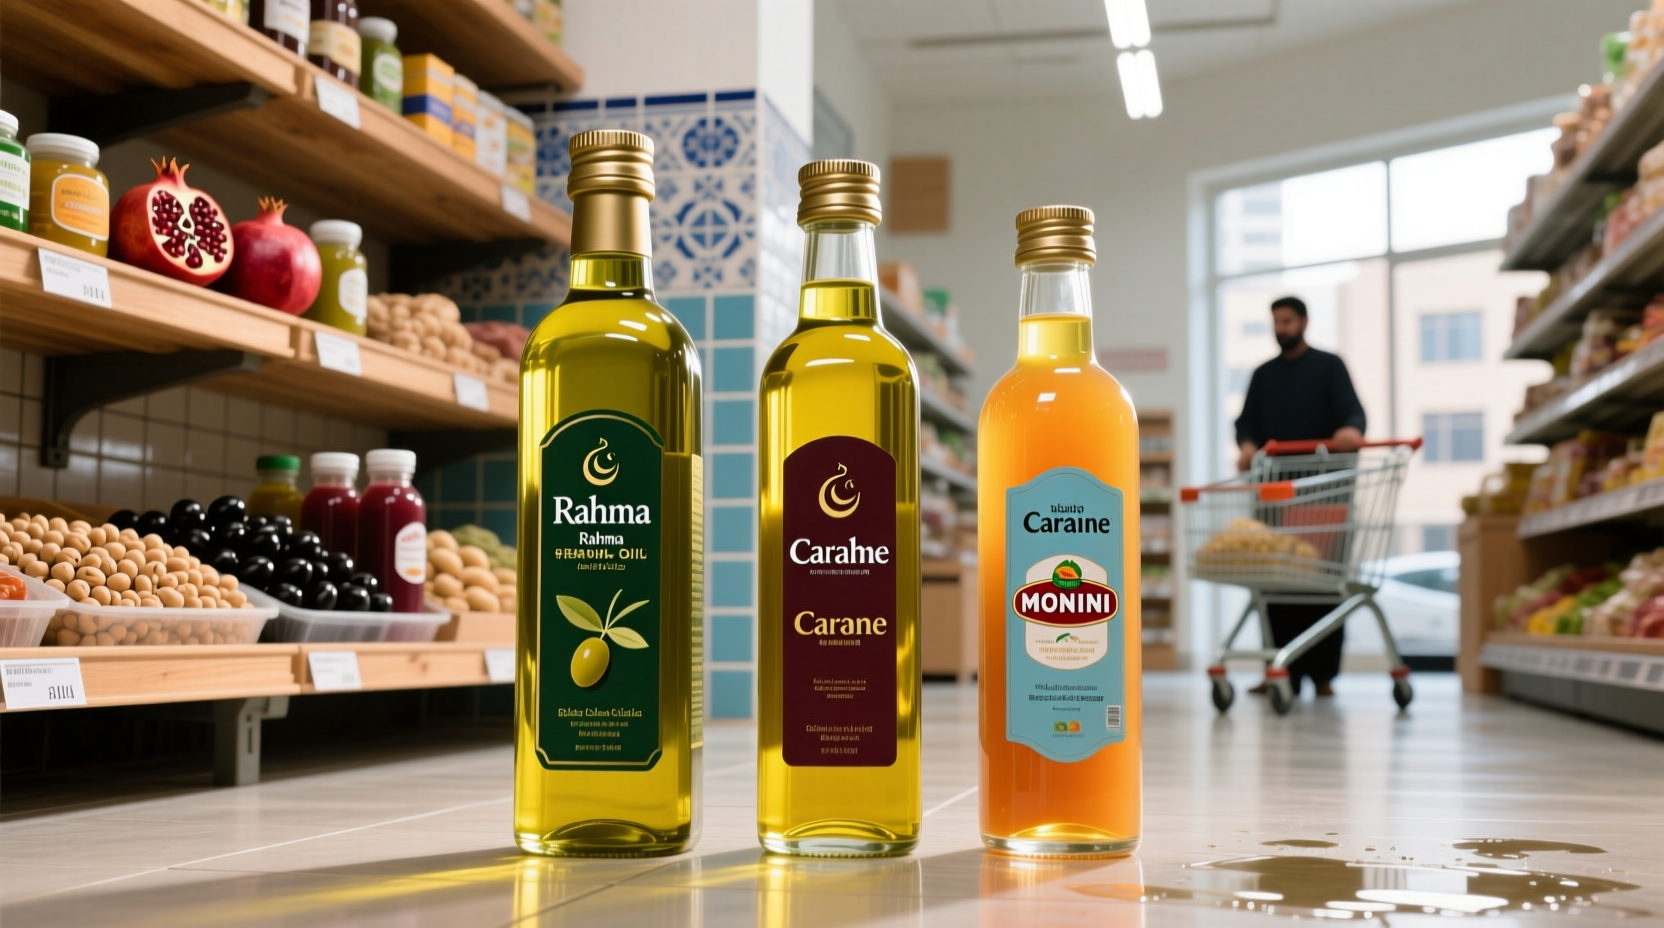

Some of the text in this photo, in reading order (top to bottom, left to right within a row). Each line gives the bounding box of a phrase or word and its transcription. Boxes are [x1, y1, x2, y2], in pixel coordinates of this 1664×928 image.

[553, 495, 651, 525] Rahma
[579, 531, 624, 545] Rahma
[1021, 592, 1110, 613] MONINI
[794, 611, 887, 635] Carane
